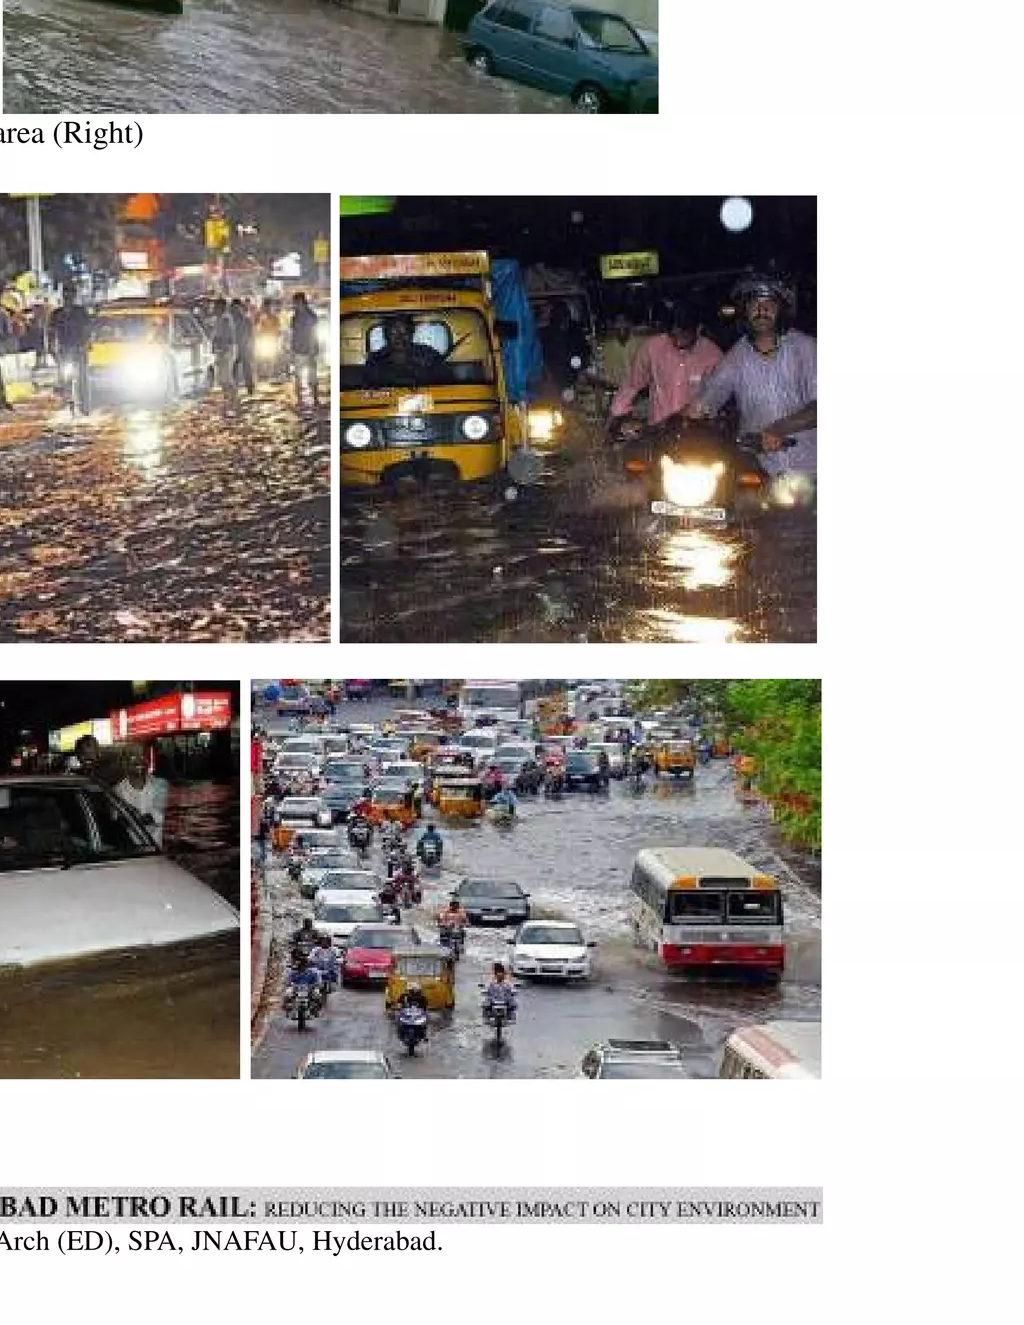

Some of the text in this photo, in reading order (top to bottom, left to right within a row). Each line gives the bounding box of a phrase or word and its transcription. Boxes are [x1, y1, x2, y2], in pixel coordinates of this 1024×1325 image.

[53, 120, 143, 151] (Right)
[66, 1196, 172, 1218] METRO
[179, 1196, 257, 1218] RAIL:
[264, 1201, 367, 1218] REDUCING
[375, 1201, 409, 1218] THE
[414, 1201, 511, 1218] NEGATIVE
[516, 1201, 589, 1218] IMPACT
[592, 1201, 621, 1218] ON
[626, 1201, 673, 1218] CITY
[676, 1201, 821, 1218] ENVIRONMENT
[57, 1230, 120, 1256] (ED),
[128, 1230, 184, 1255] SPA,
[191, 1230, 304, 1255] JNAFAU,
[312, 1230, 443, 1257] Hyderabad.
